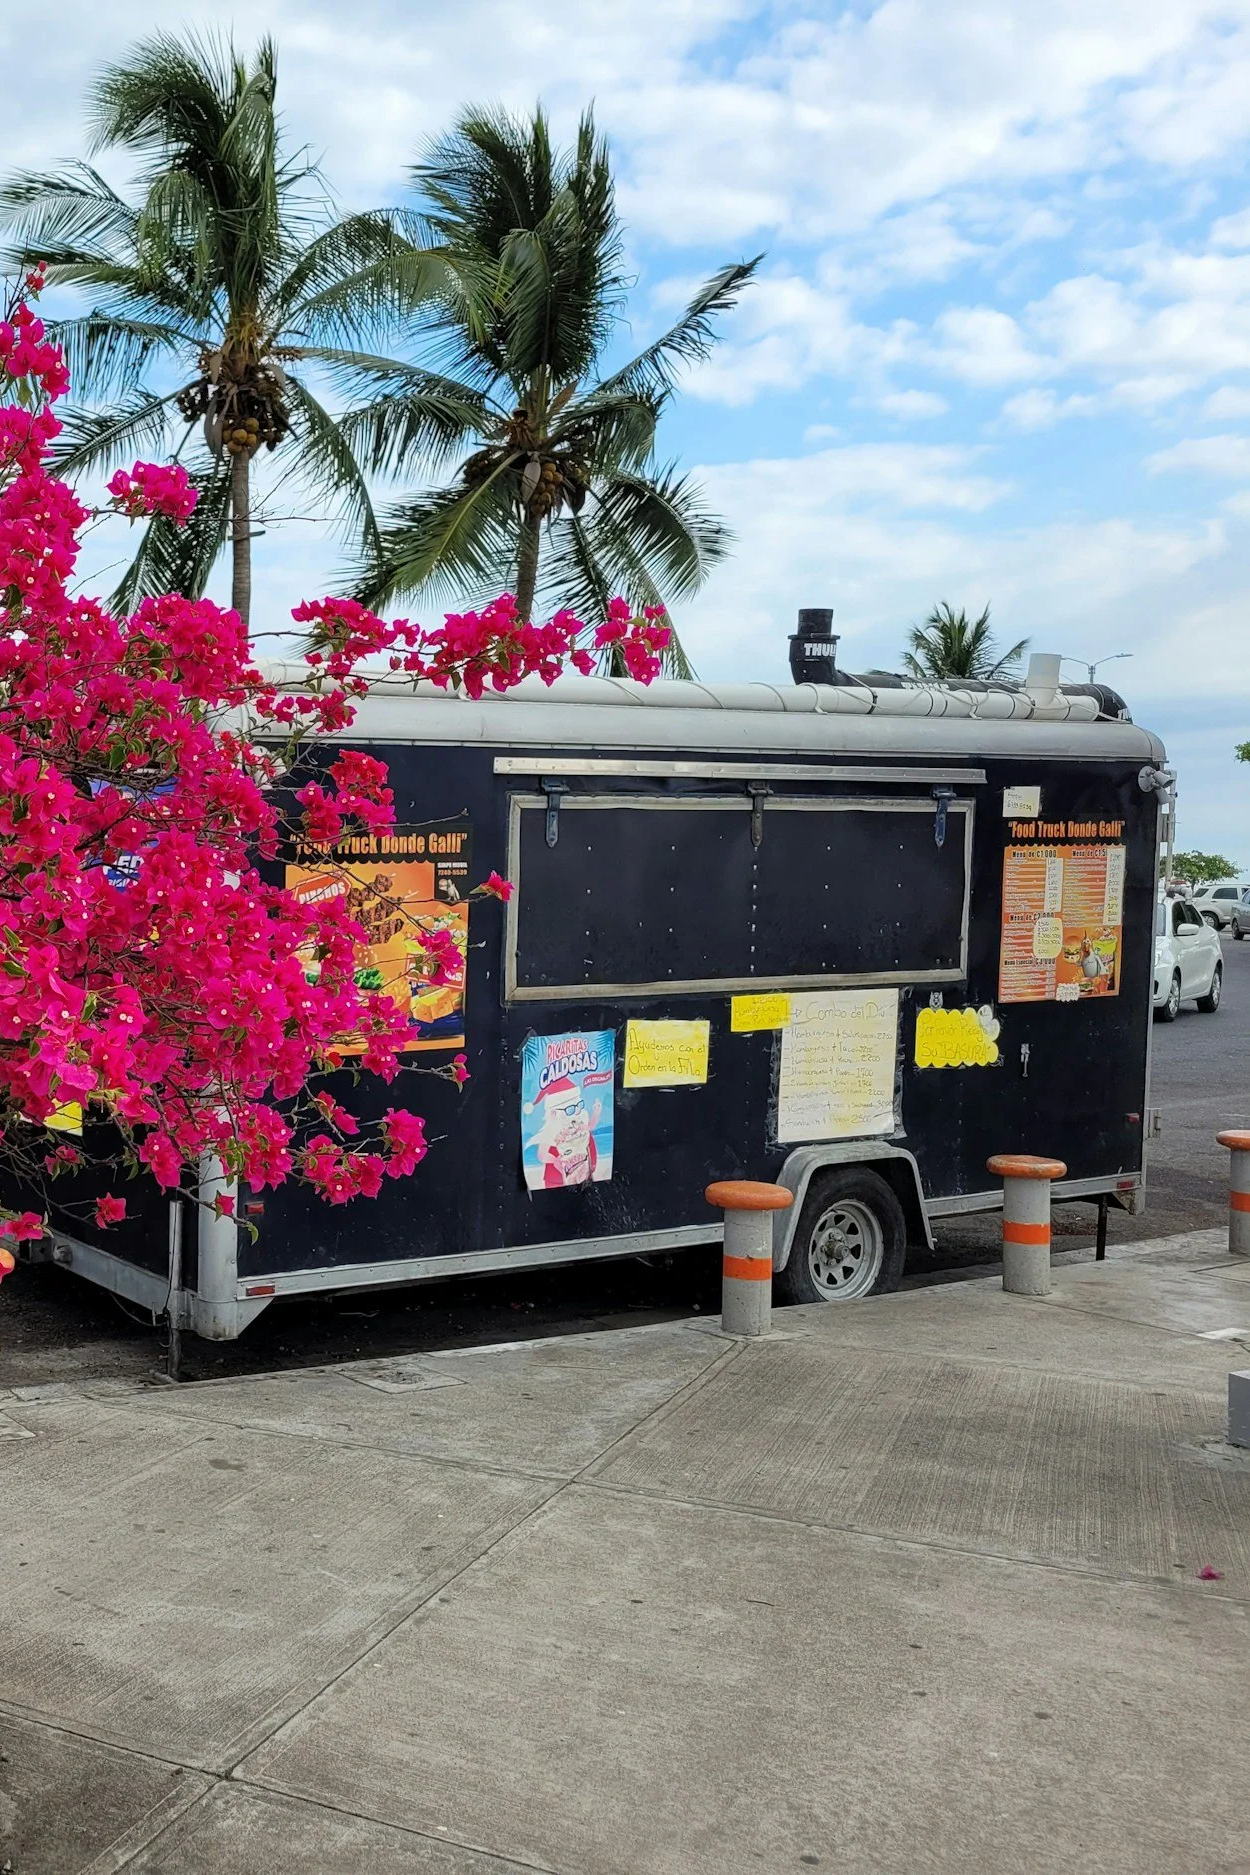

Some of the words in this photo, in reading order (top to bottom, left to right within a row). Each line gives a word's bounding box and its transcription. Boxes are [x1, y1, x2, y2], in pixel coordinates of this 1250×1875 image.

[1037, 821, 1065, 838] Truck
[1068, 820, 1097, 838] Donde
[381, 833, 425, 854] Donde
[806, 1000, 847, 1021] Combo
[547, 1039, 588, 1063] PICARITAS
[540, 1051, 598, 1089] CALDOSAS
[628, 1054, 656, 1075] Orden
